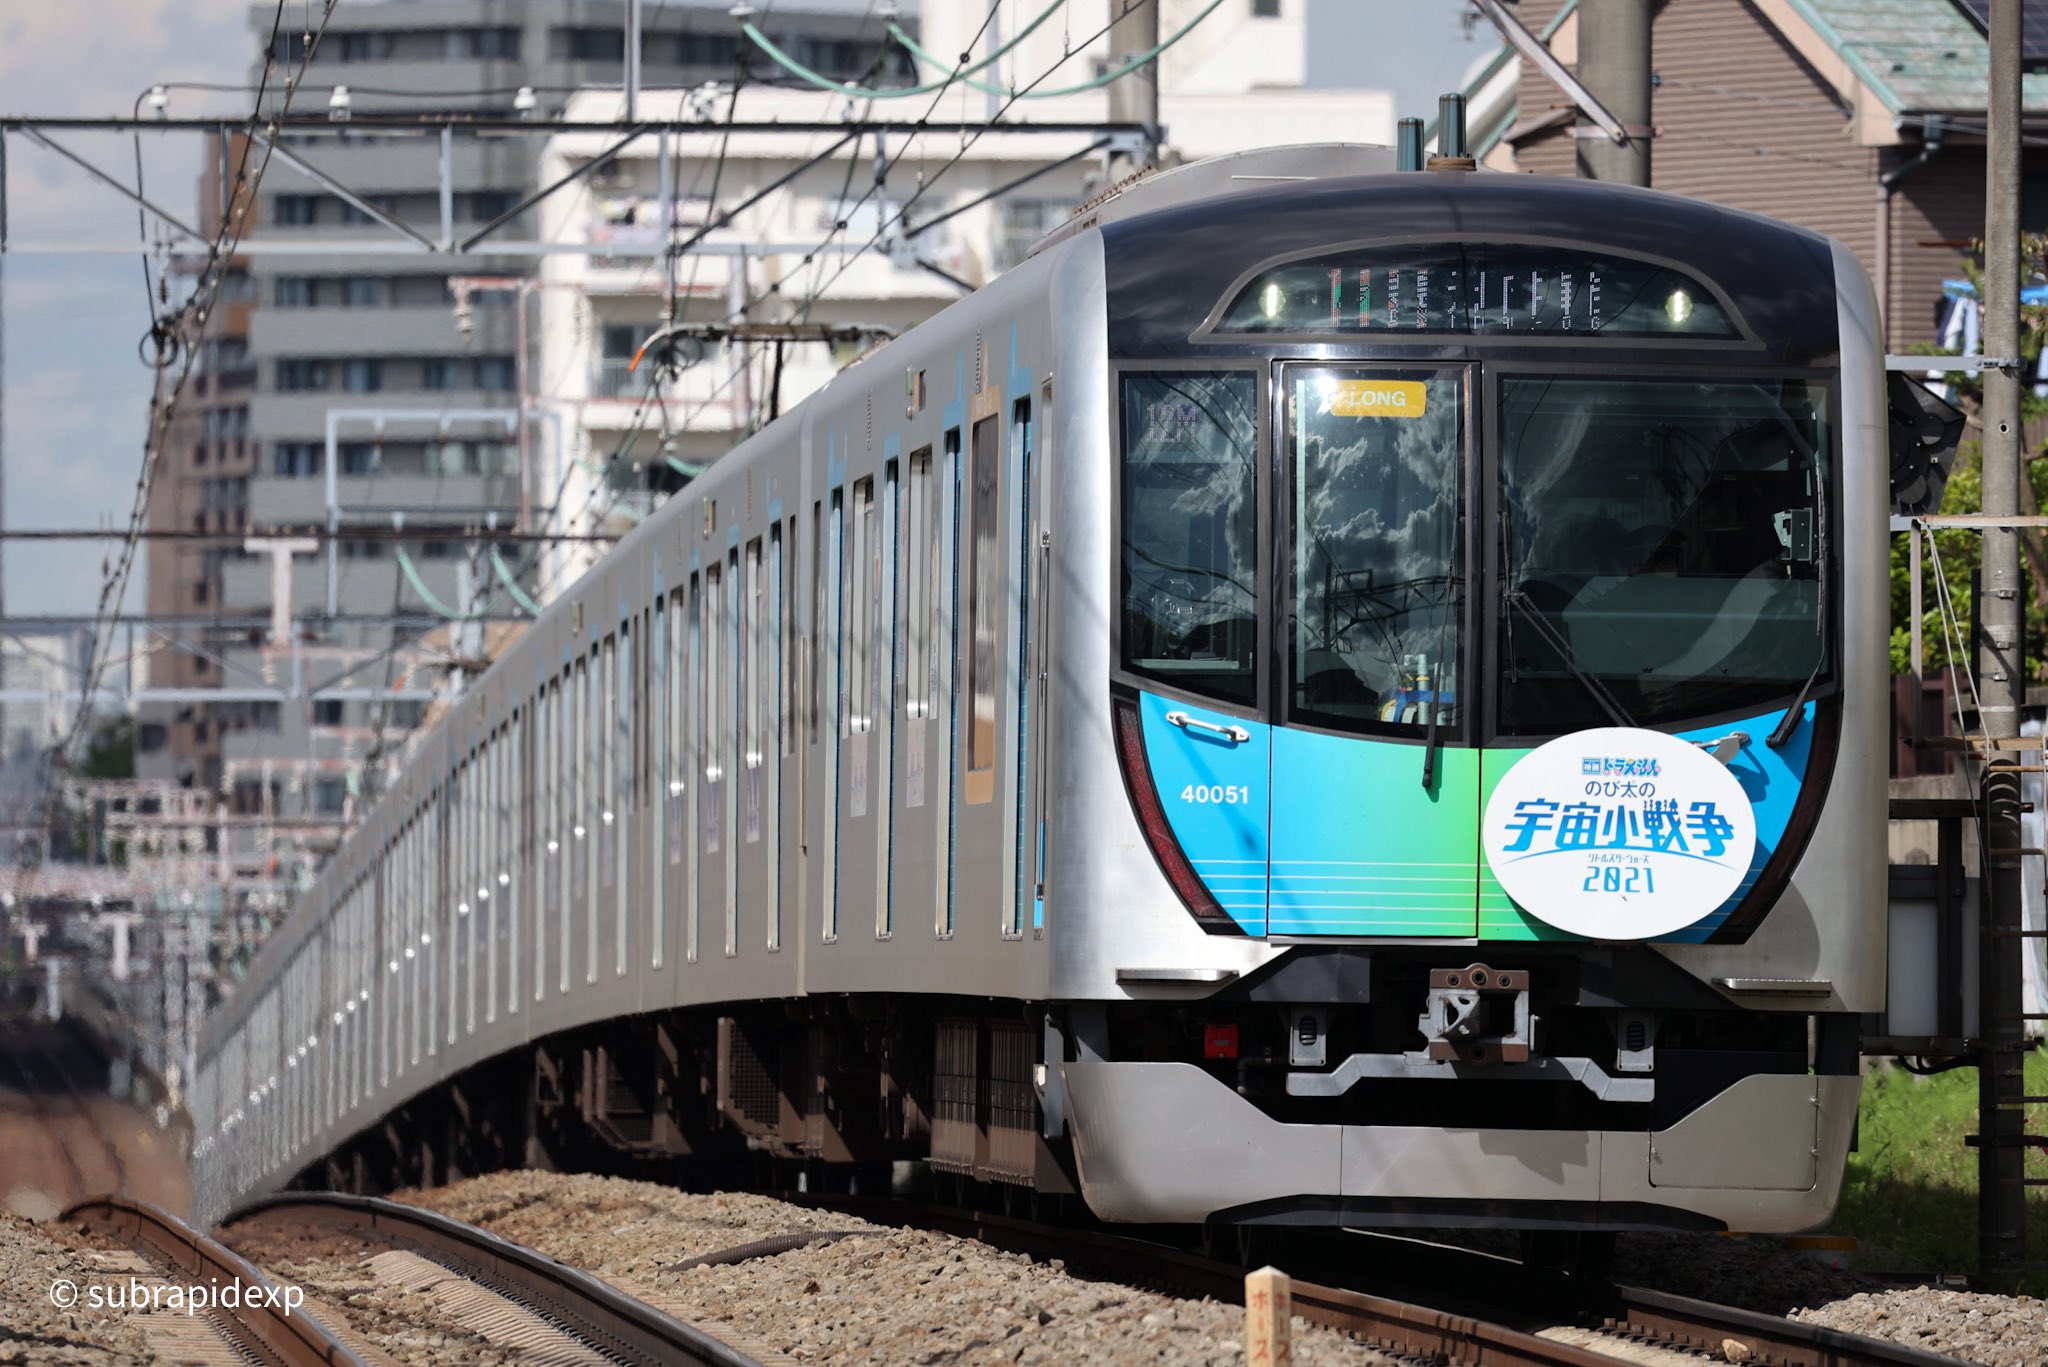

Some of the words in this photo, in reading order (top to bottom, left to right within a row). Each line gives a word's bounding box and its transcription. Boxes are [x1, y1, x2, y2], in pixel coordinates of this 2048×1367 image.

[1349, 390, 1407, 407] LONG
[1181, 784, 1248, 804] 40051
[1585, 780, 1656, 798] のび太の
[1502, 798, 1735, 856] 宇宙小戦争
[1583, 866, 1654, 893] 2021
